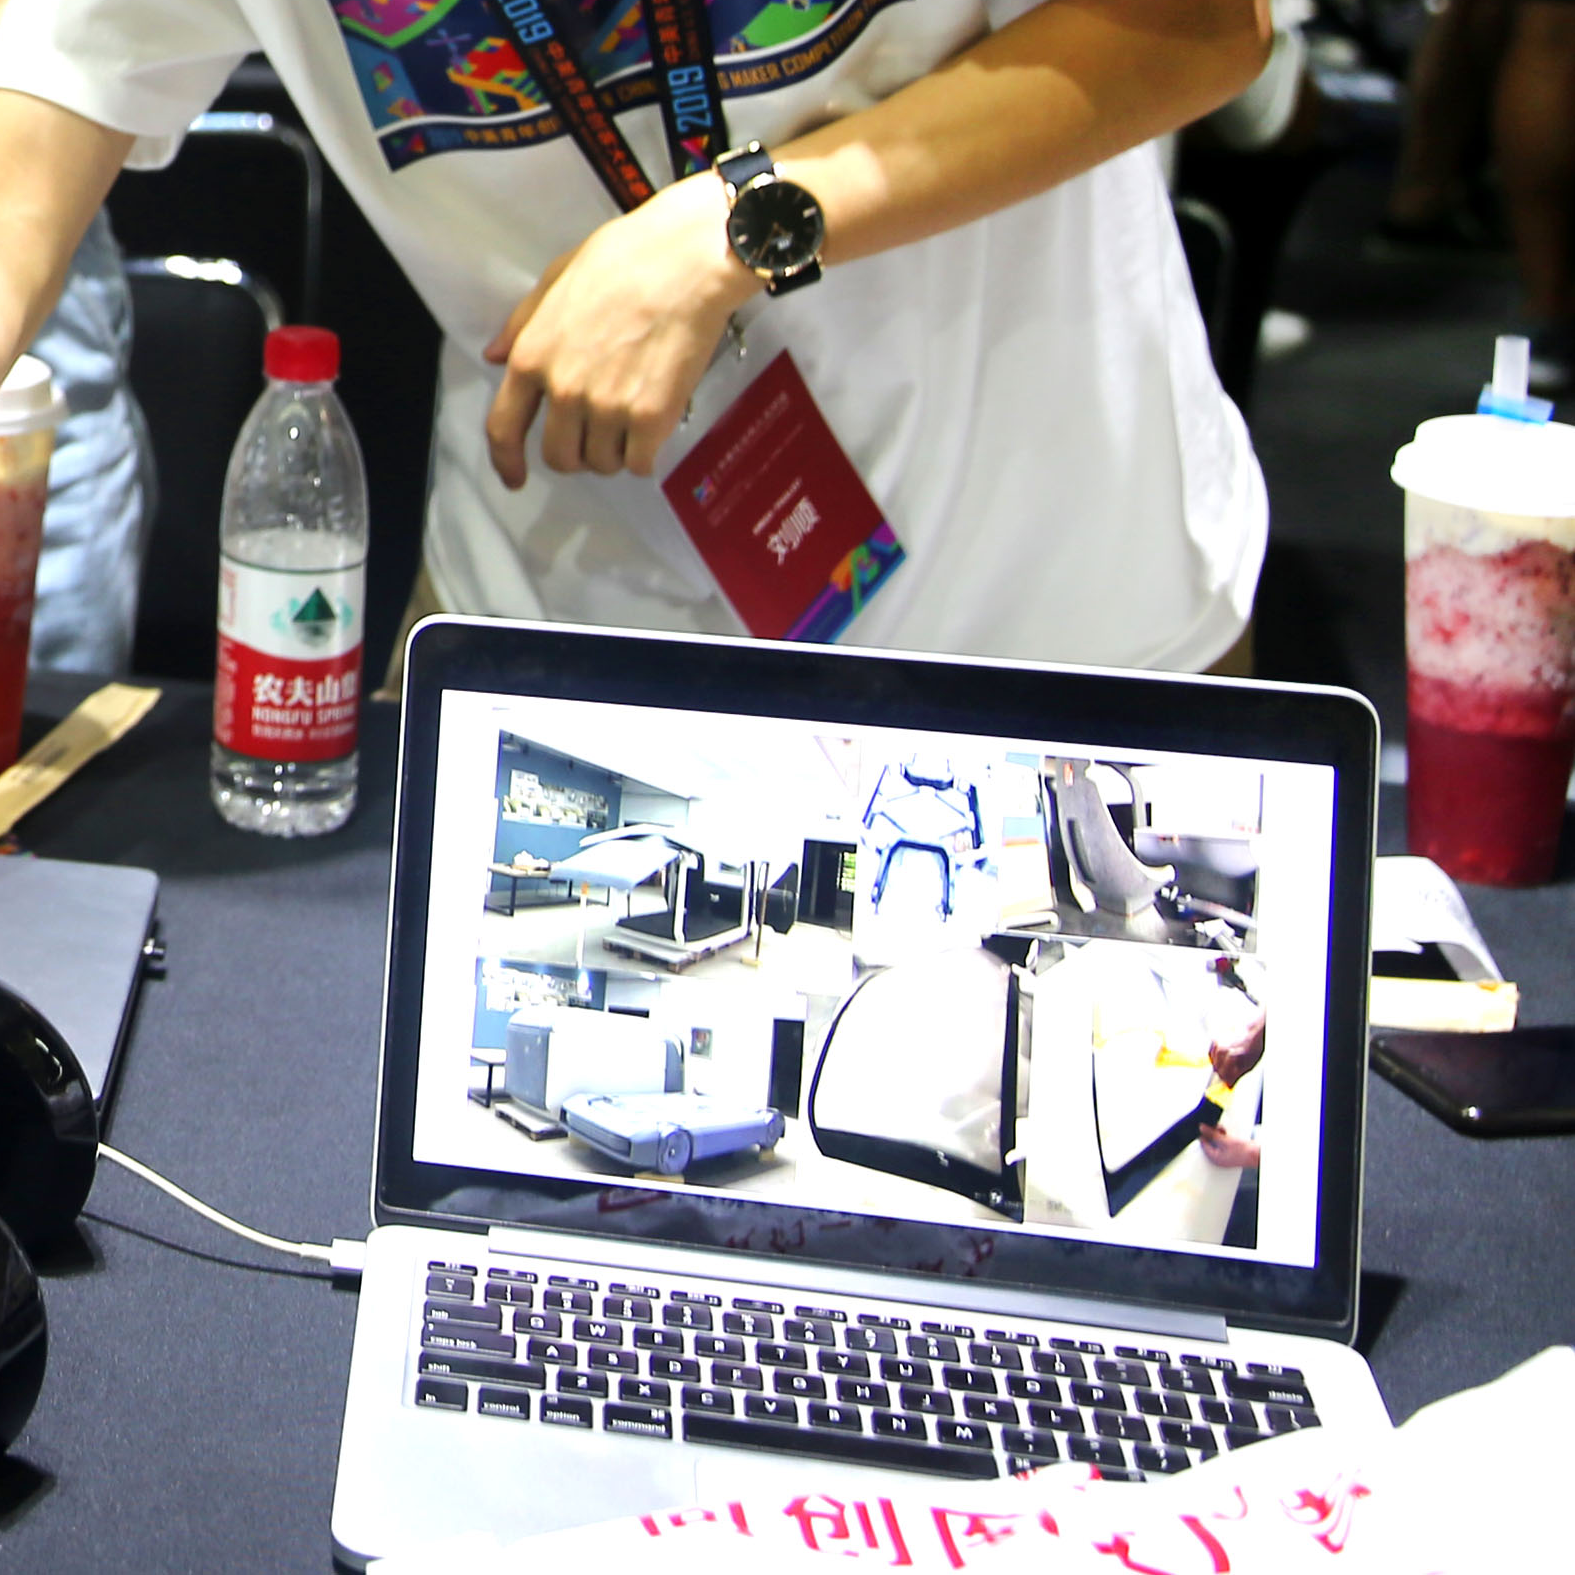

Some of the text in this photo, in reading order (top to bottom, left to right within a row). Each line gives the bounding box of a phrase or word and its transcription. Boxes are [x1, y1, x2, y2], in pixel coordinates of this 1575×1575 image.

[667, 65, 714, 134] 2019
[589, 1323, 606, 1336] W
[955, 1426, 973, 1439] M
